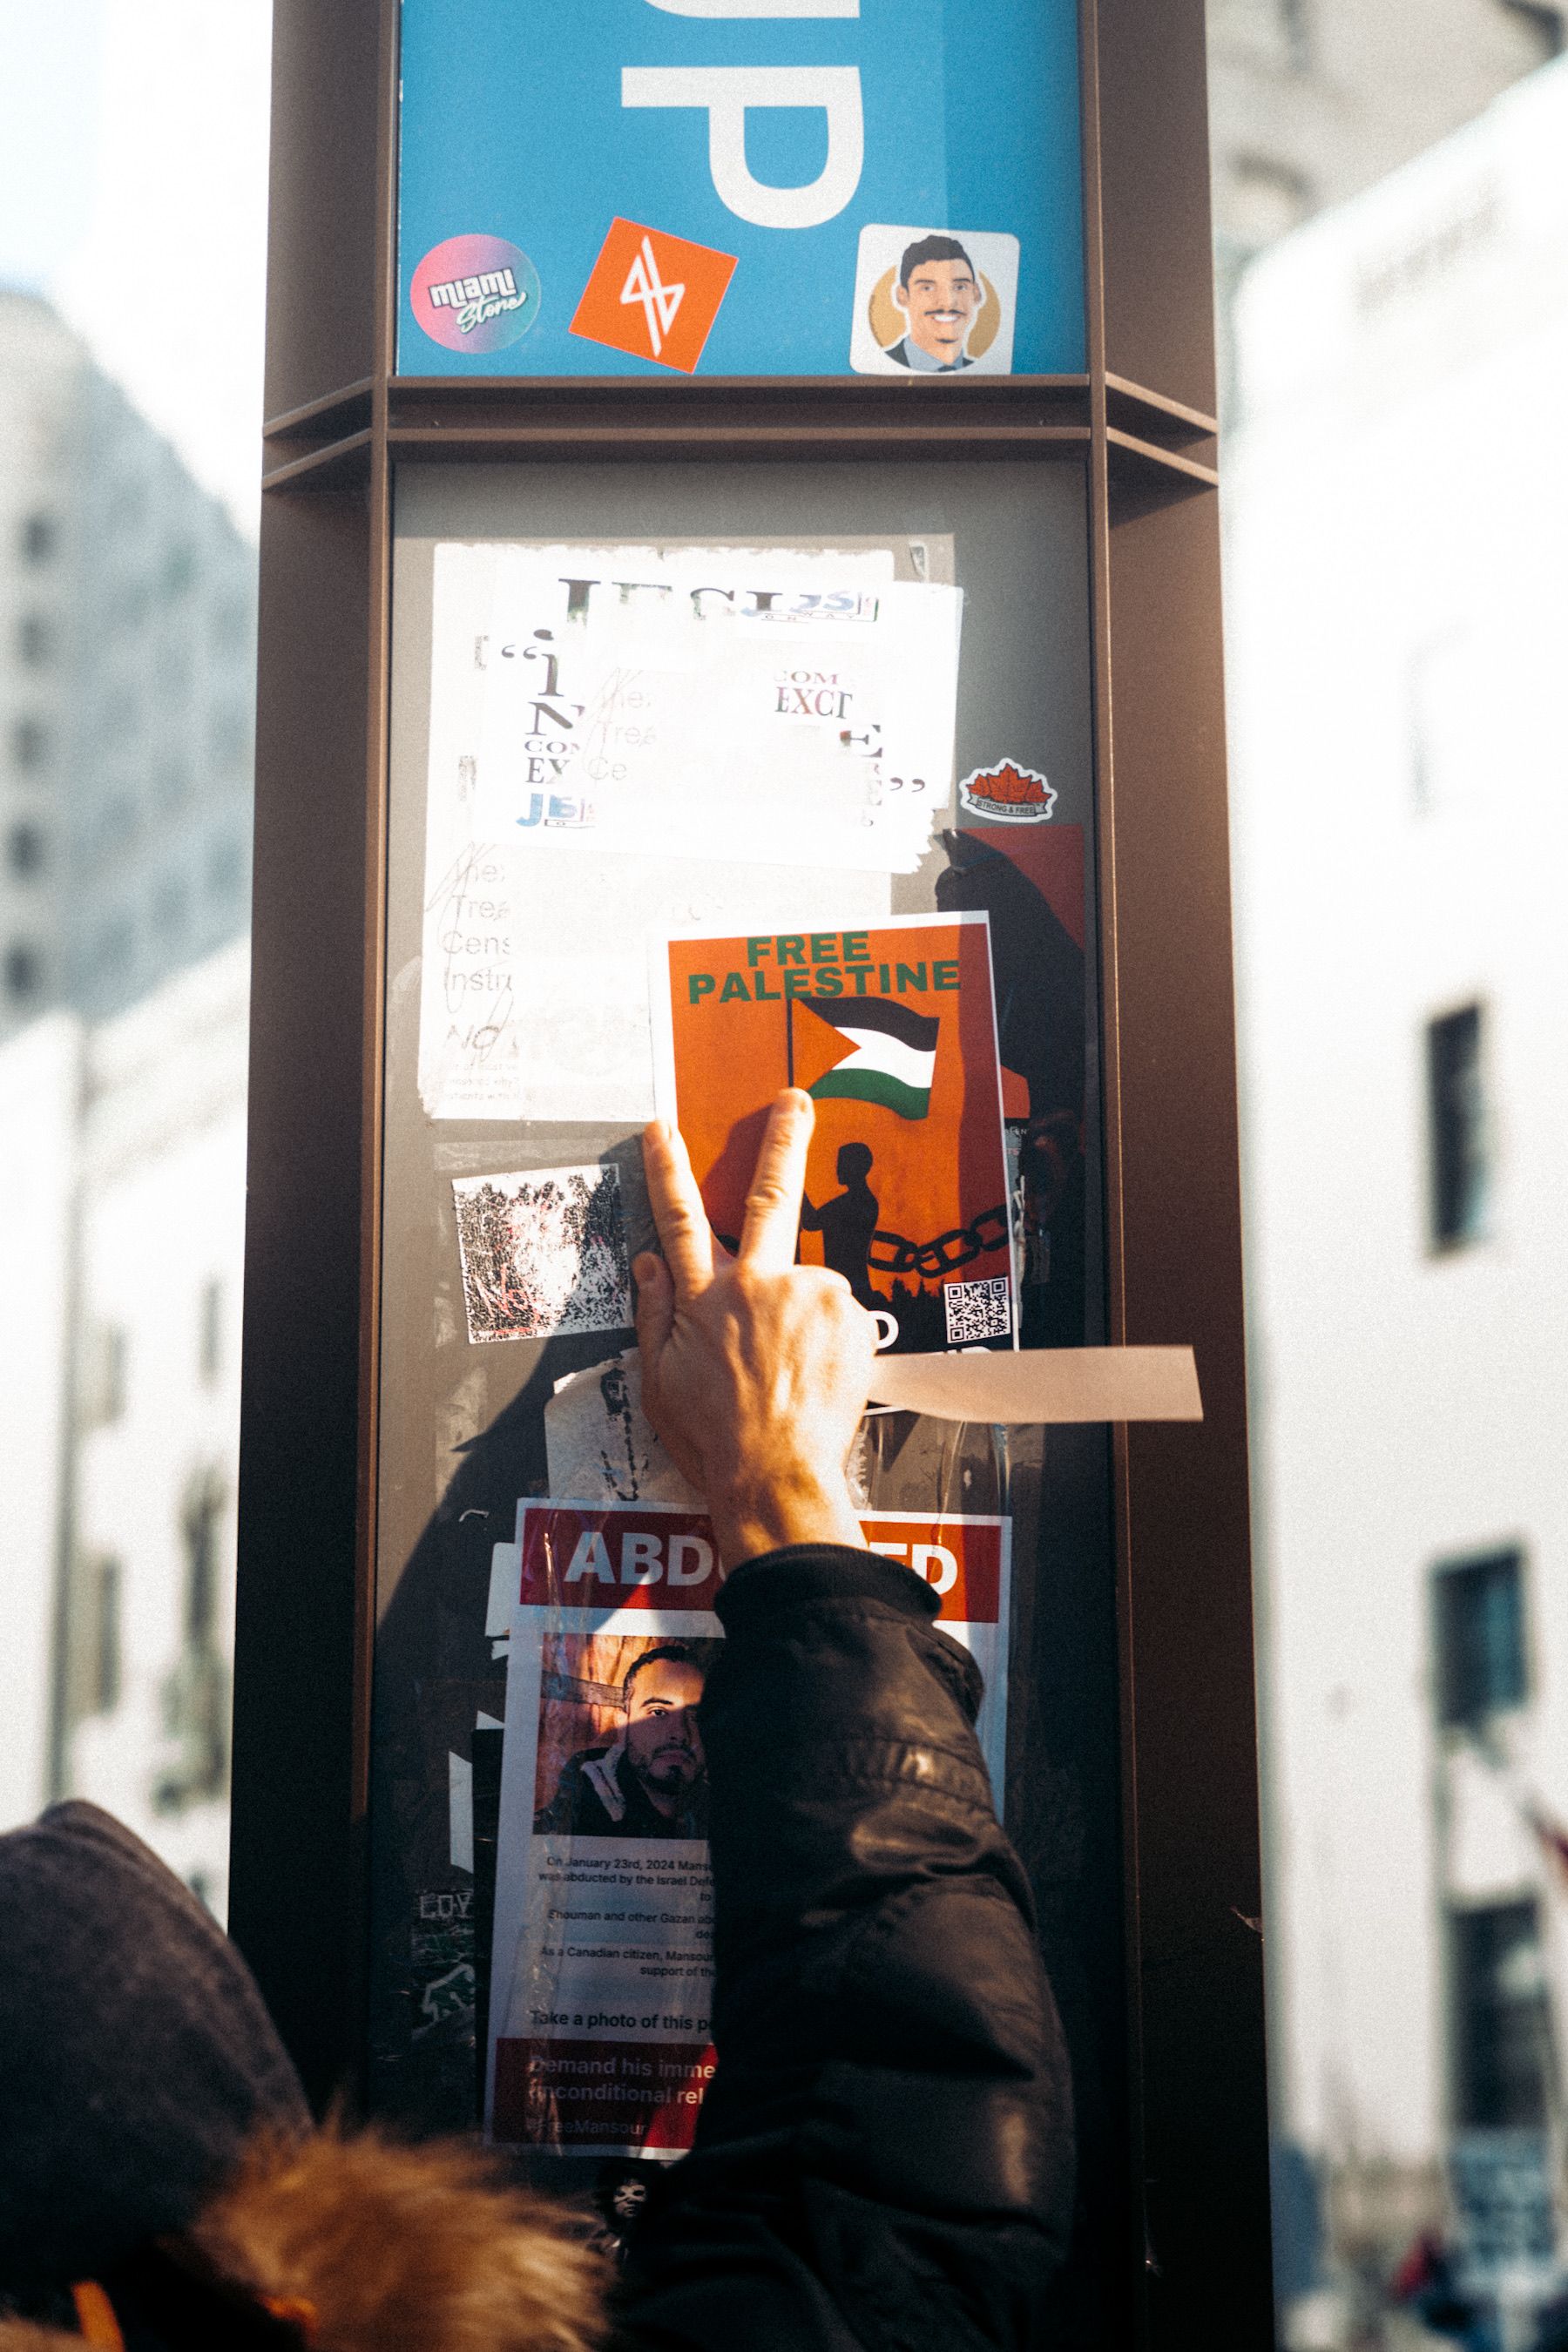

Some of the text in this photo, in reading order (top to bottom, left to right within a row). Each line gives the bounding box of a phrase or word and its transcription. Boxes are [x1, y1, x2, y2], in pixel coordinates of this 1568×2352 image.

[621, 0, 864, 229] P
[456, 291, 527, 334] Store
[977, 799, 1035, 814] STRONG & FREE
[747, 930, 871, 967] FREE
[688, 960, 961, 1004] PALESTINE
[547, 1856, 563, 1868] On
[565, 1857, 612, 1871] January
[614, 1858, 642, 1871] 23rd,
[646, 1859, 675, 1870] 2024
[564, 1873, 616, 1883] abducted
[619, 1875, 632, 1886] by
[636, 1875, 654, 1885] the
[657, 1875, 686, 1886] Israel
[604, 1911, 625, 1921] and
[628, 1912, 658, 1923] other
[660, 1914, 695, 1924] Gazan
[541, 1946, 555, 1957] As
[567, 1947, 620, 1958] Canadian
[623, 1949, 663, 1961] citizen,
[640, 1965, 684, 1977] support
[686, 1966, 698, 1977] of
[530, 2011, 569, 2025] Take
[573, 2014, 584, 2025] a
[587, 2012, 636, 2030] photo
[641, 2014, 659, 2028] of
[663, 2015, 693, 2030] this
[529, 2055, 616, 2075] Demand
[621, 2058, 652, 2076] his
[676, 2087, 704, 2105] rel
